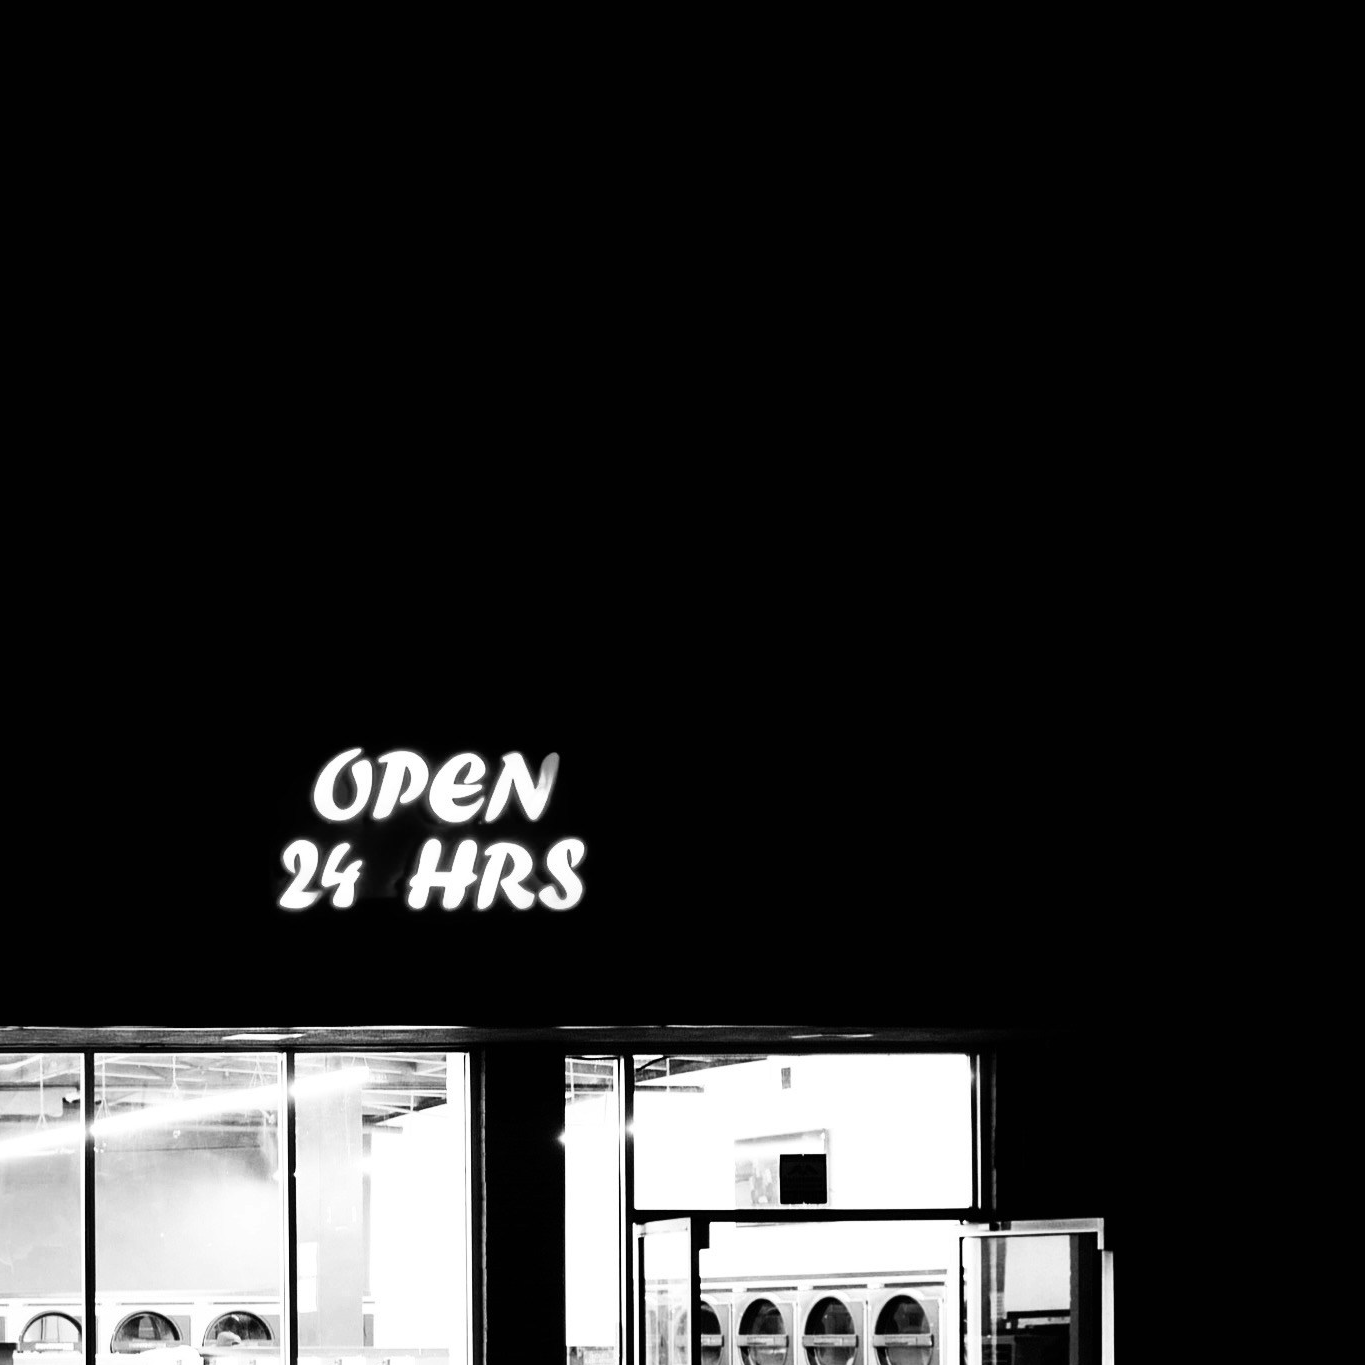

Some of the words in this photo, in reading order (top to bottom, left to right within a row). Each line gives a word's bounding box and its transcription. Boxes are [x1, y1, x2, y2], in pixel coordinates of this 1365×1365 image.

[314, 748, 558, 823] OPEN
[279, 840, 363, 909] 24
[408, 838, 585, 910] HRS
